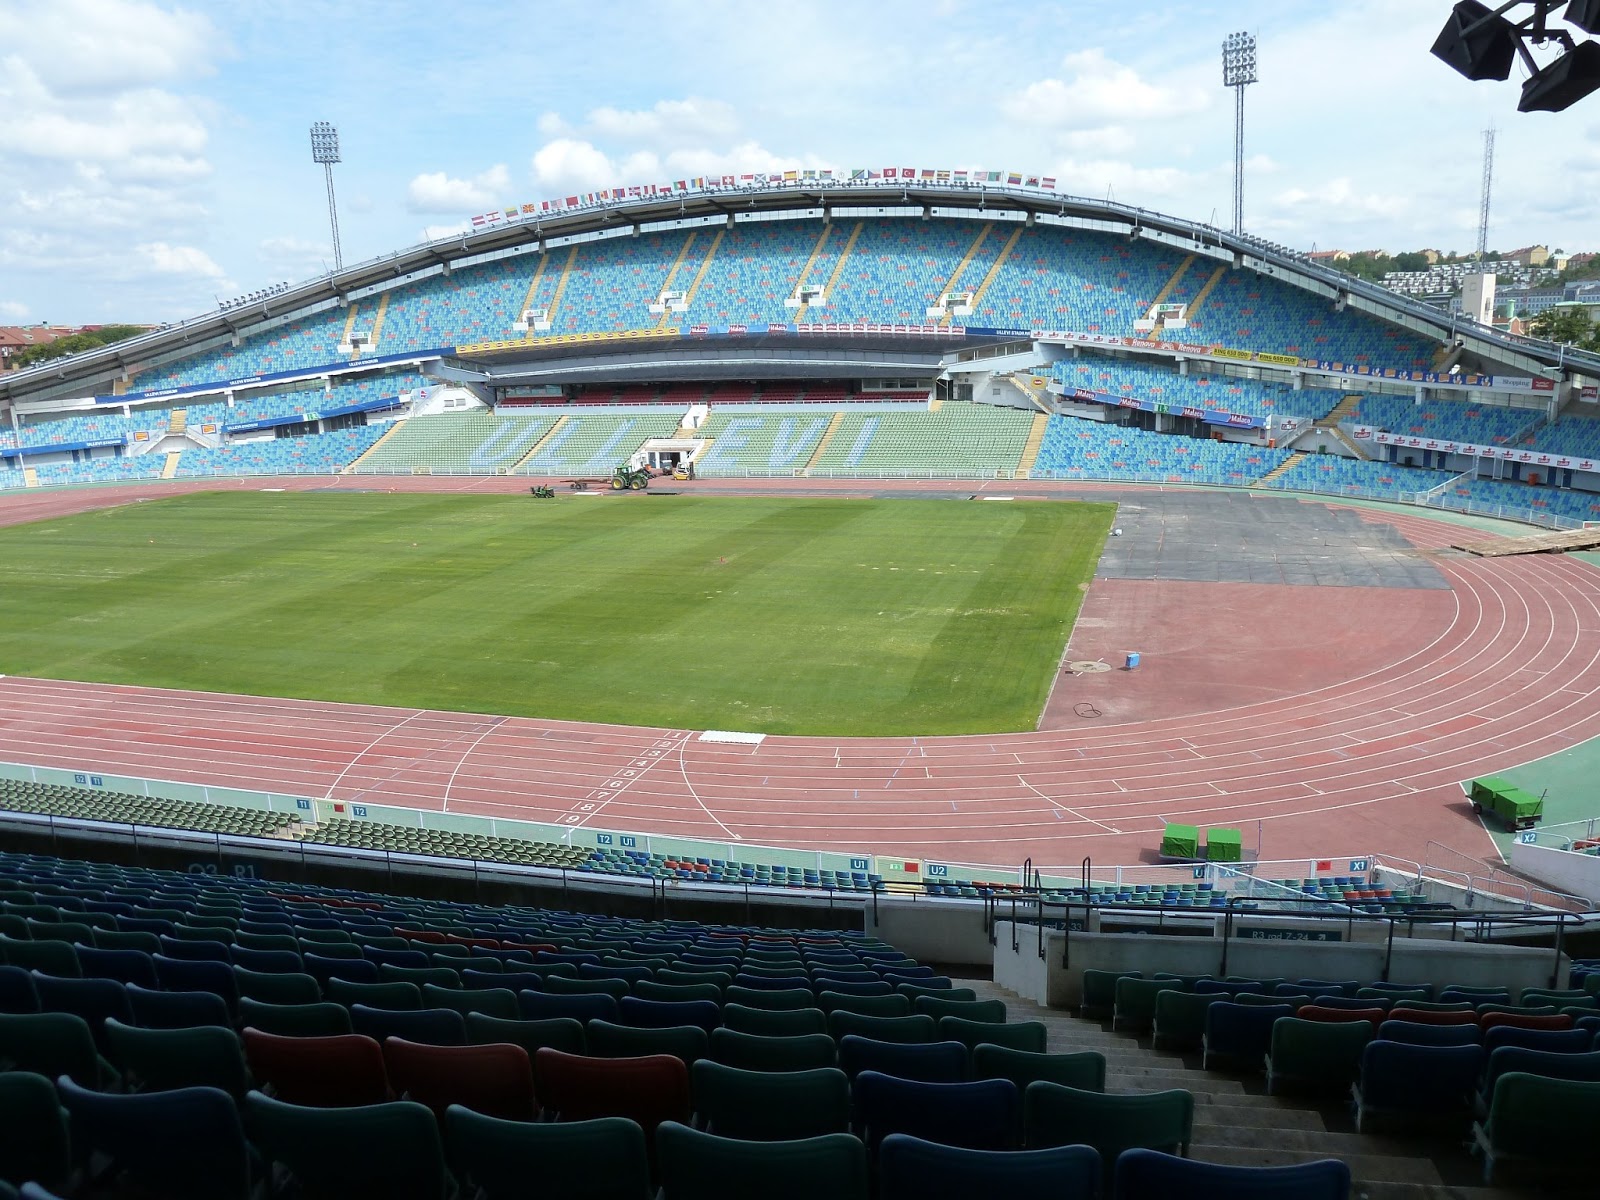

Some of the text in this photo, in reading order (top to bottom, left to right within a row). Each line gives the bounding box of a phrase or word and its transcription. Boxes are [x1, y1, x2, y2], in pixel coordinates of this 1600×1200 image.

[1131, 339, 1156, 348] Renova
[1177, 343, 1202, 353] Renova
[1076, 389, 1095, 399] Malaco
[1121, 398, 1140, 408] Malaco
[1184, 408, 1203, 417] Malaco
[1231, 415, 1251, 424] Malaco
[623, 769, 637, 777] 5
[609, 780, 623, 788] 6
[597, 791, 611, 799] 7
[355, 807, 365, 816] T2
[580, 803, 595, 811] 8
[565, 815, 580, 823] 9
[599, 835, 611, 844] T2
[622, 837, 633, 846] U1
[1524, 833, 1536, 843] X2
[853, 860, 865, 869] U1
[1353, 861, 1365, 871] X1
[931, 866, 945, 875] U2
[1252, 930, 1265, 940] R3
[1268, 932, 1283, 940] rad
